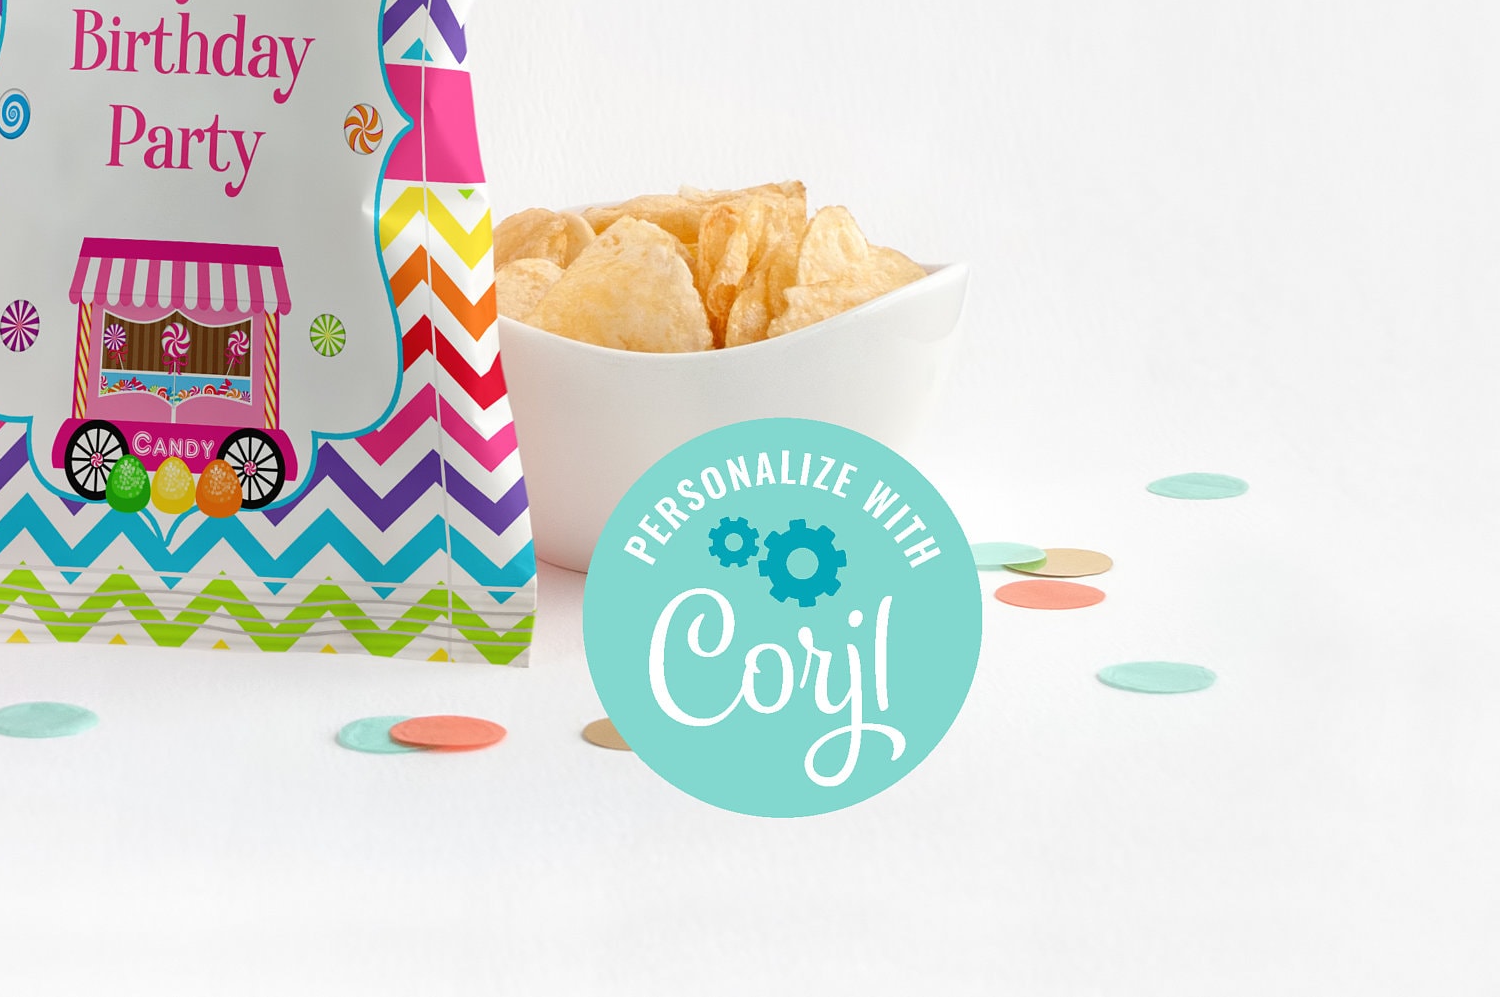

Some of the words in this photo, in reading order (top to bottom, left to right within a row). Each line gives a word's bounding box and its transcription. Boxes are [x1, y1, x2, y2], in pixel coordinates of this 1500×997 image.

[70, 9, 315, 104] Birthday
[105, 105, 266, 198] Party
[132, 430, 215, 460] CANDY
